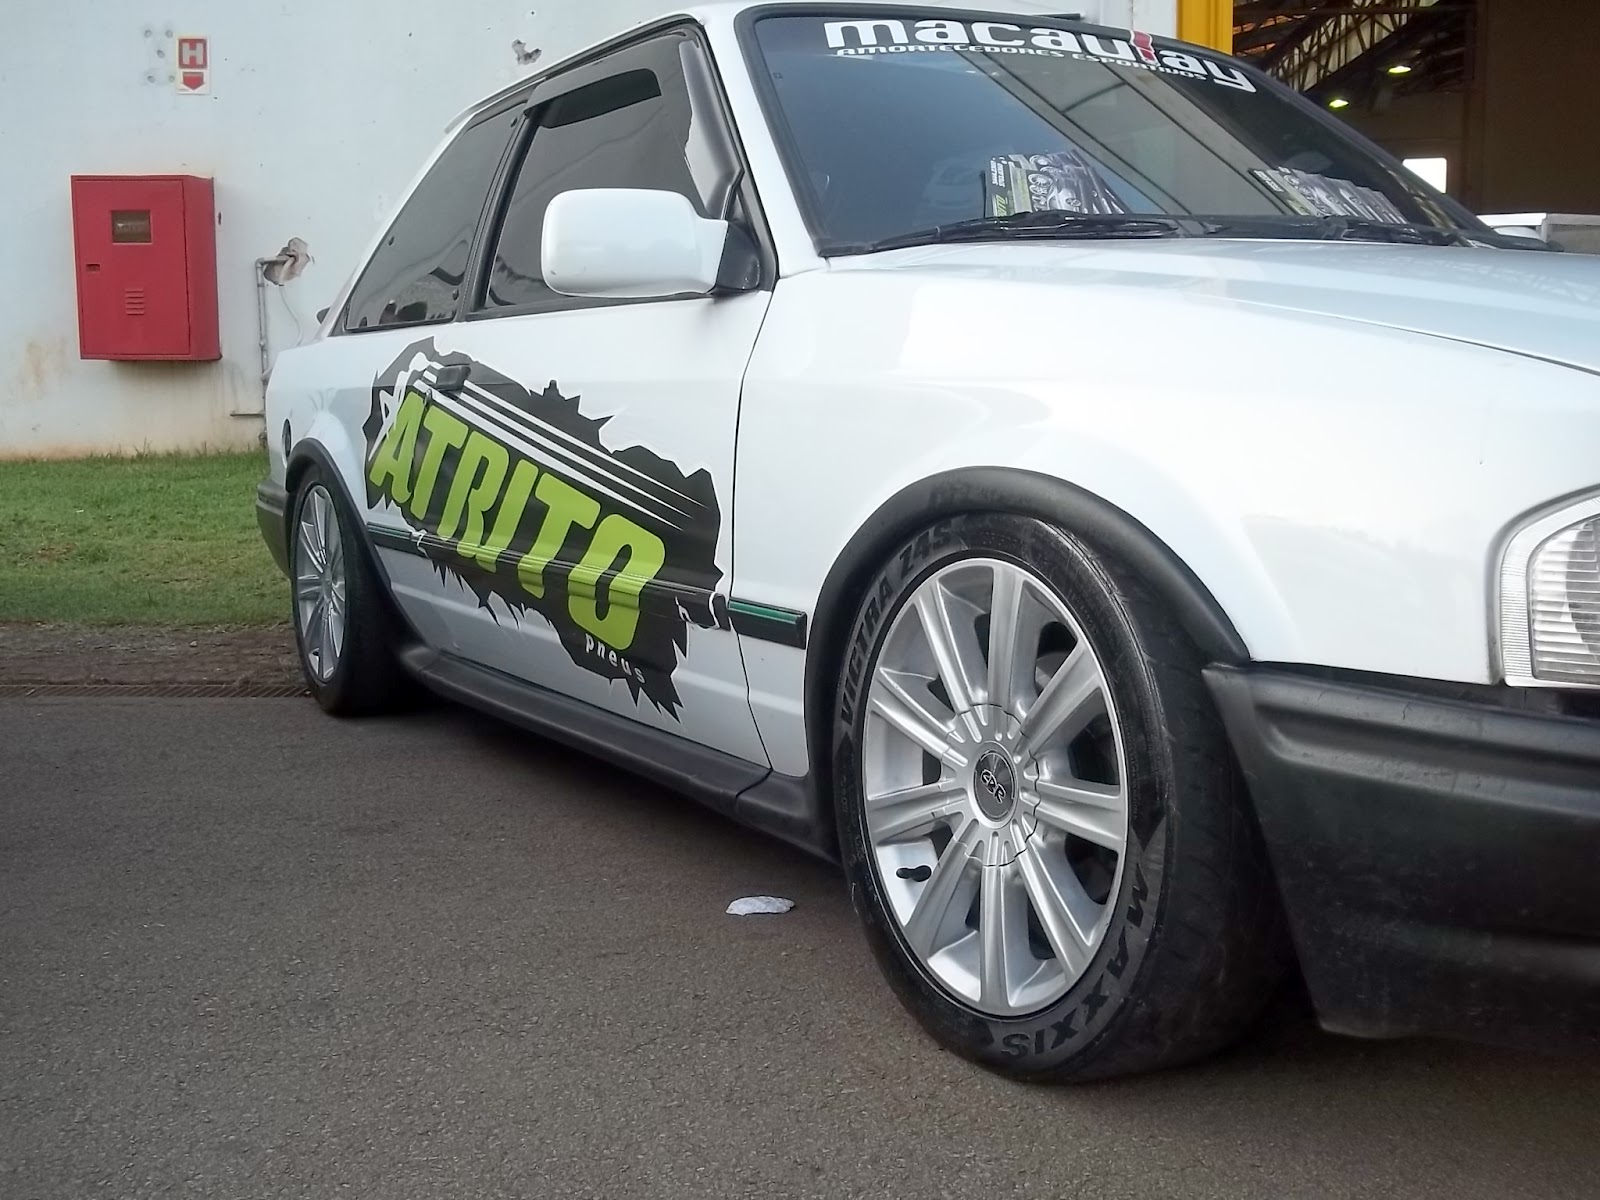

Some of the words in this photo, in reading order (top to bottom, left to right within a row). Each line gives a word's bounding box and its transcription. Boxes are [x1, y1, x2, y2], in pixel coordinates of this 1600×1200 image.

[182, 42, 204, 65] H
[369, 390, 666, 651] ATRITO
[584, 632, 646, 684] pneus
[840, 575, 894, 726] VICTRA
[1001, 862, 1149, 1056] MAXXIS
